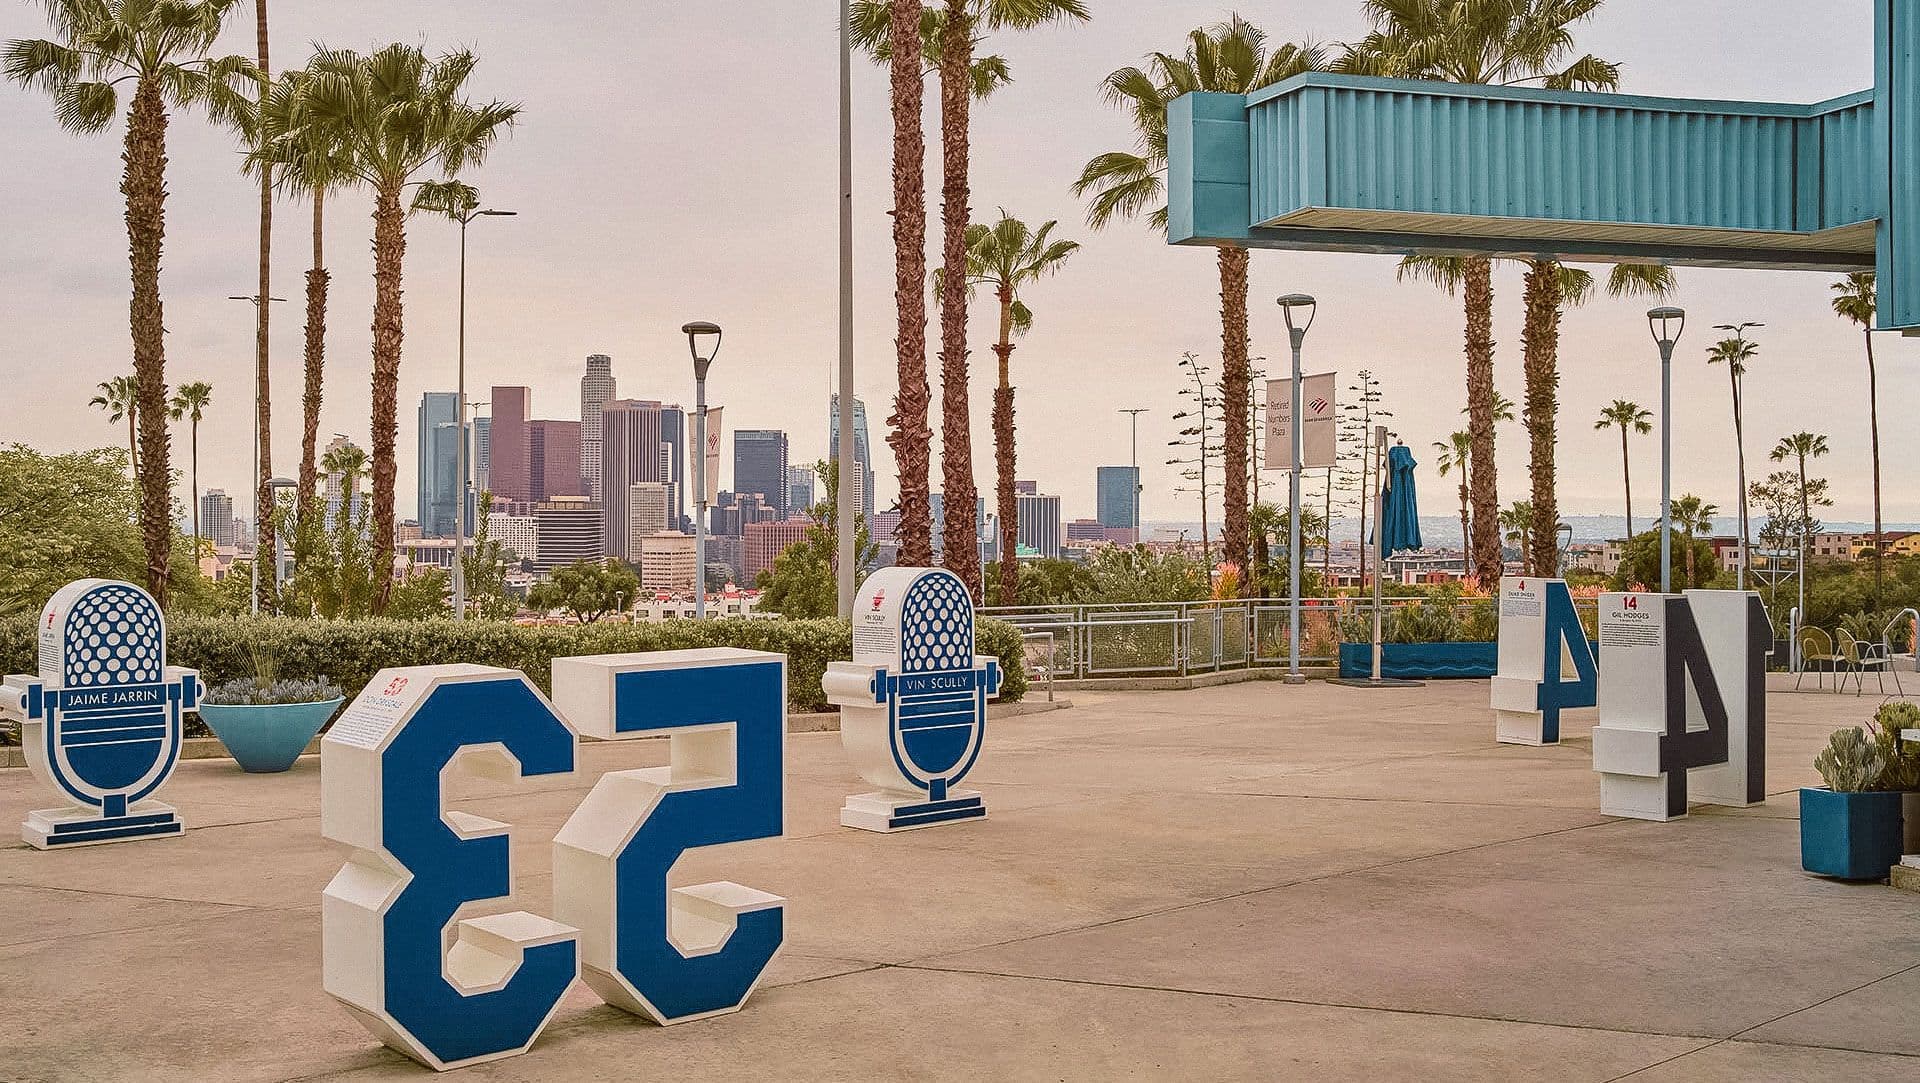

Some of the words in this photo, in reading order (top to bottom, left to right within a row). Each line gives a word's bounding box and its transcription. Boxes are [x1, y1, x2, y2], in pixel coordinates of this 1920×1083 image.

[1270, 399, 1290, 410] Retired
[1268, 414, 1291, 423] Numbers
[1271, 427, 1286, 436] Plaza
[1518, 580, 1525, 591] 4
[1623, 596, 1637, 610] 14
[906, 680, 925, 690] VIN
[931, 677, 968, 689] SCULLY
[68, 692, 108, 706] JAIME
[112, 689, 158, 704] JARRIN
